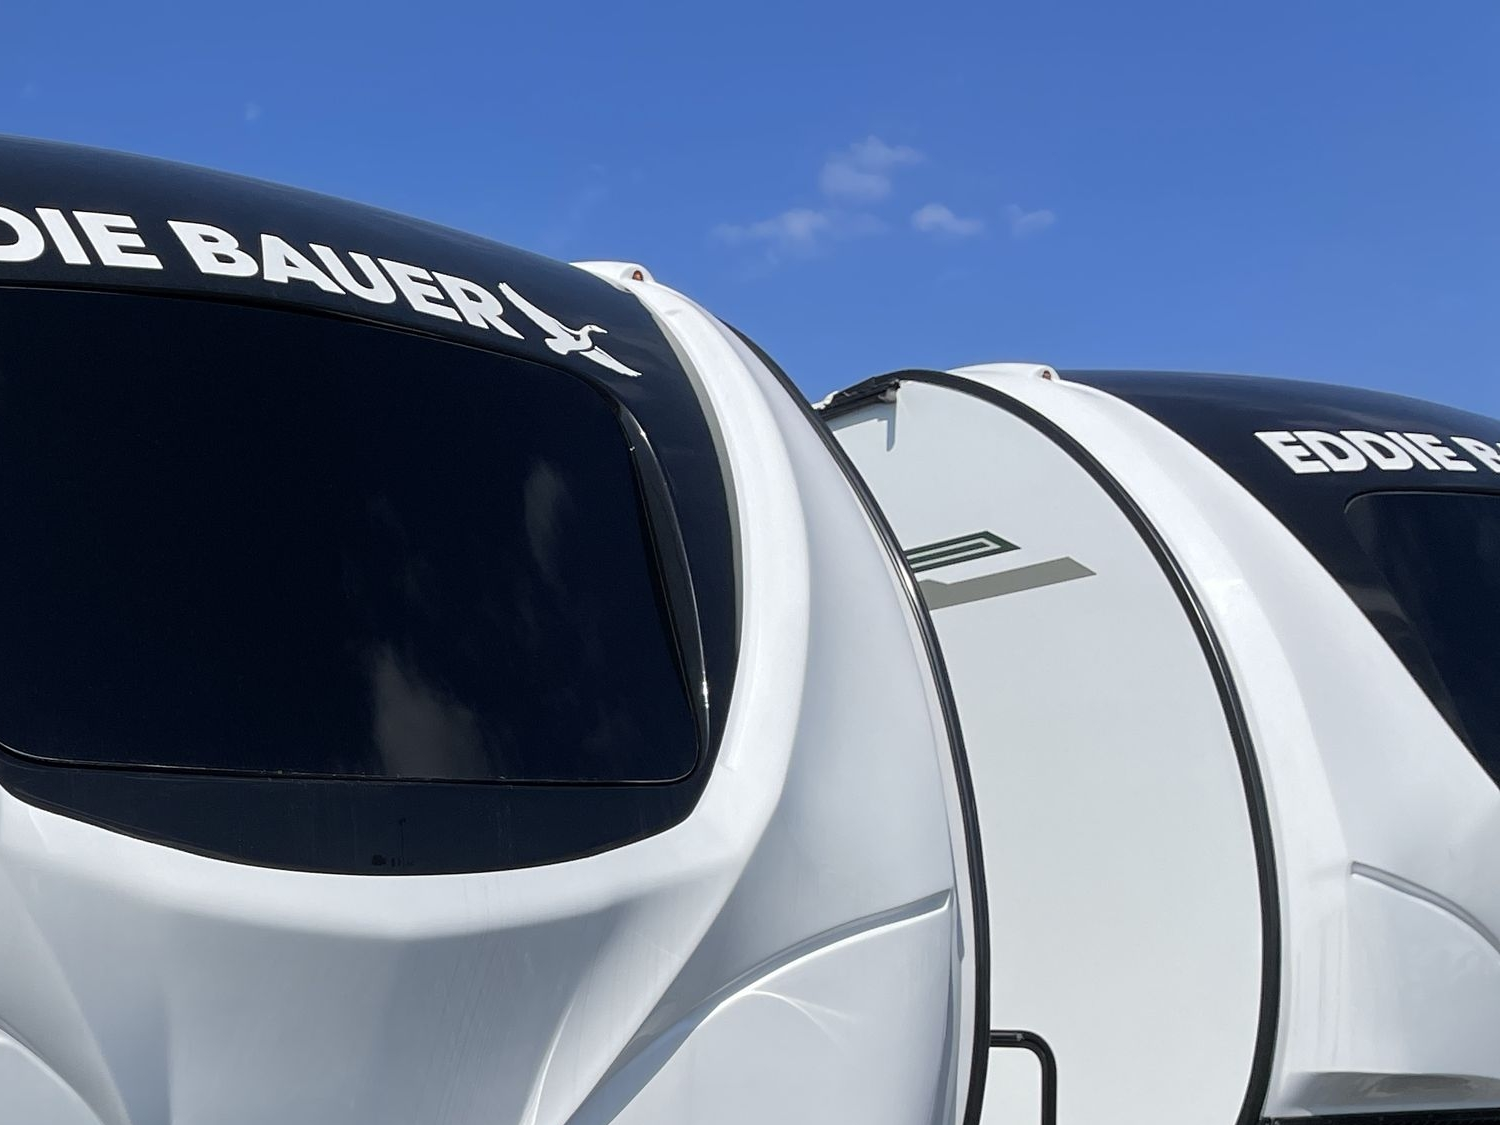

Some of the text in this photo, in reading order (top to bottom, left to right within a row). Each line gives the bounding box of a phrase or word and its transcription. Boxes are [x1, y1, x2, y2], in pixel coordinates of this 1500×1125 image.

[167, 220, 525, 339] BAUER
[1254, 430, 1500, 474] EDDIE B
